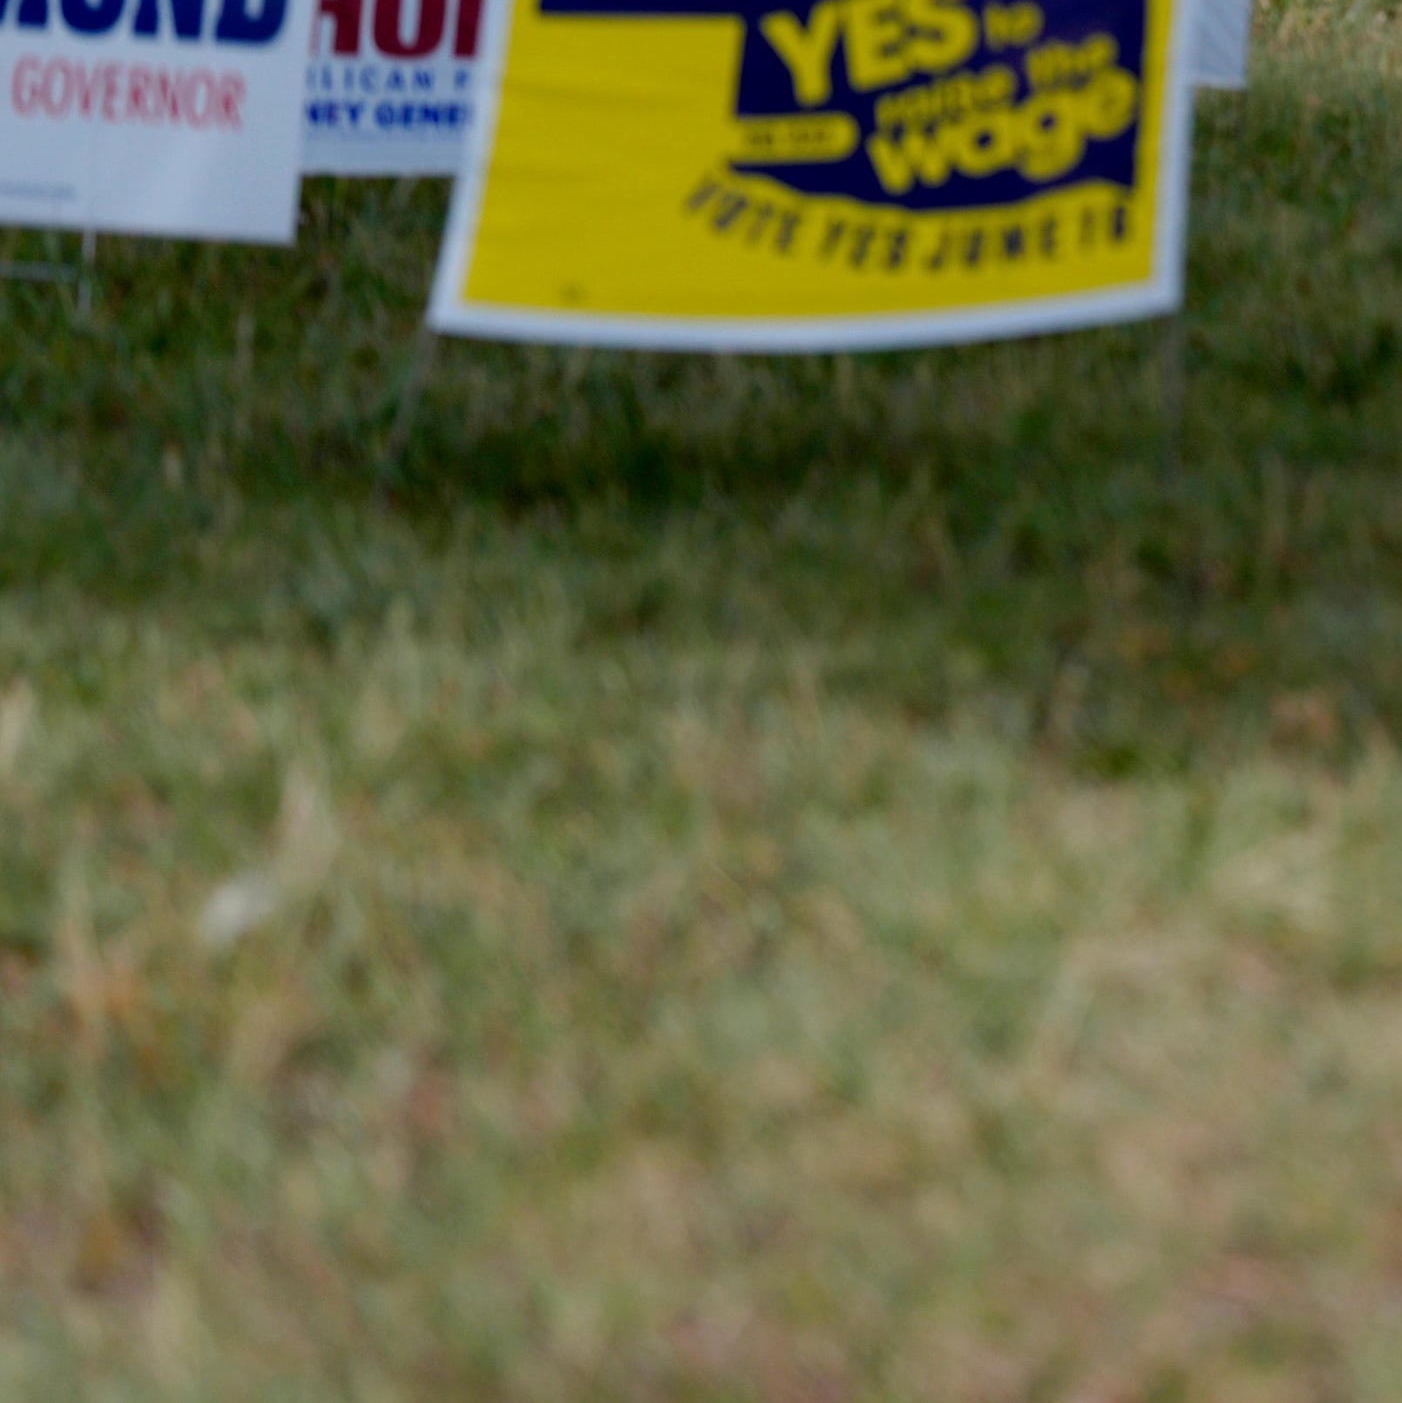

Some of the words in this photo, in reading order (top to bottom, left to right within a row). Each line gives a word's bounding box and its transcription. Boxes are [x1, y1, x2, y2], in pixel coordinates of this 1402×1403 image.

[11, 56, 247, 133] GOVERNOR
[306, 64, 433, 94] LICAN
[374, 100, 472, 128] GENE
[865, 67, 1138, 196] wage
[928, 210, 1057, 271] JUNE
